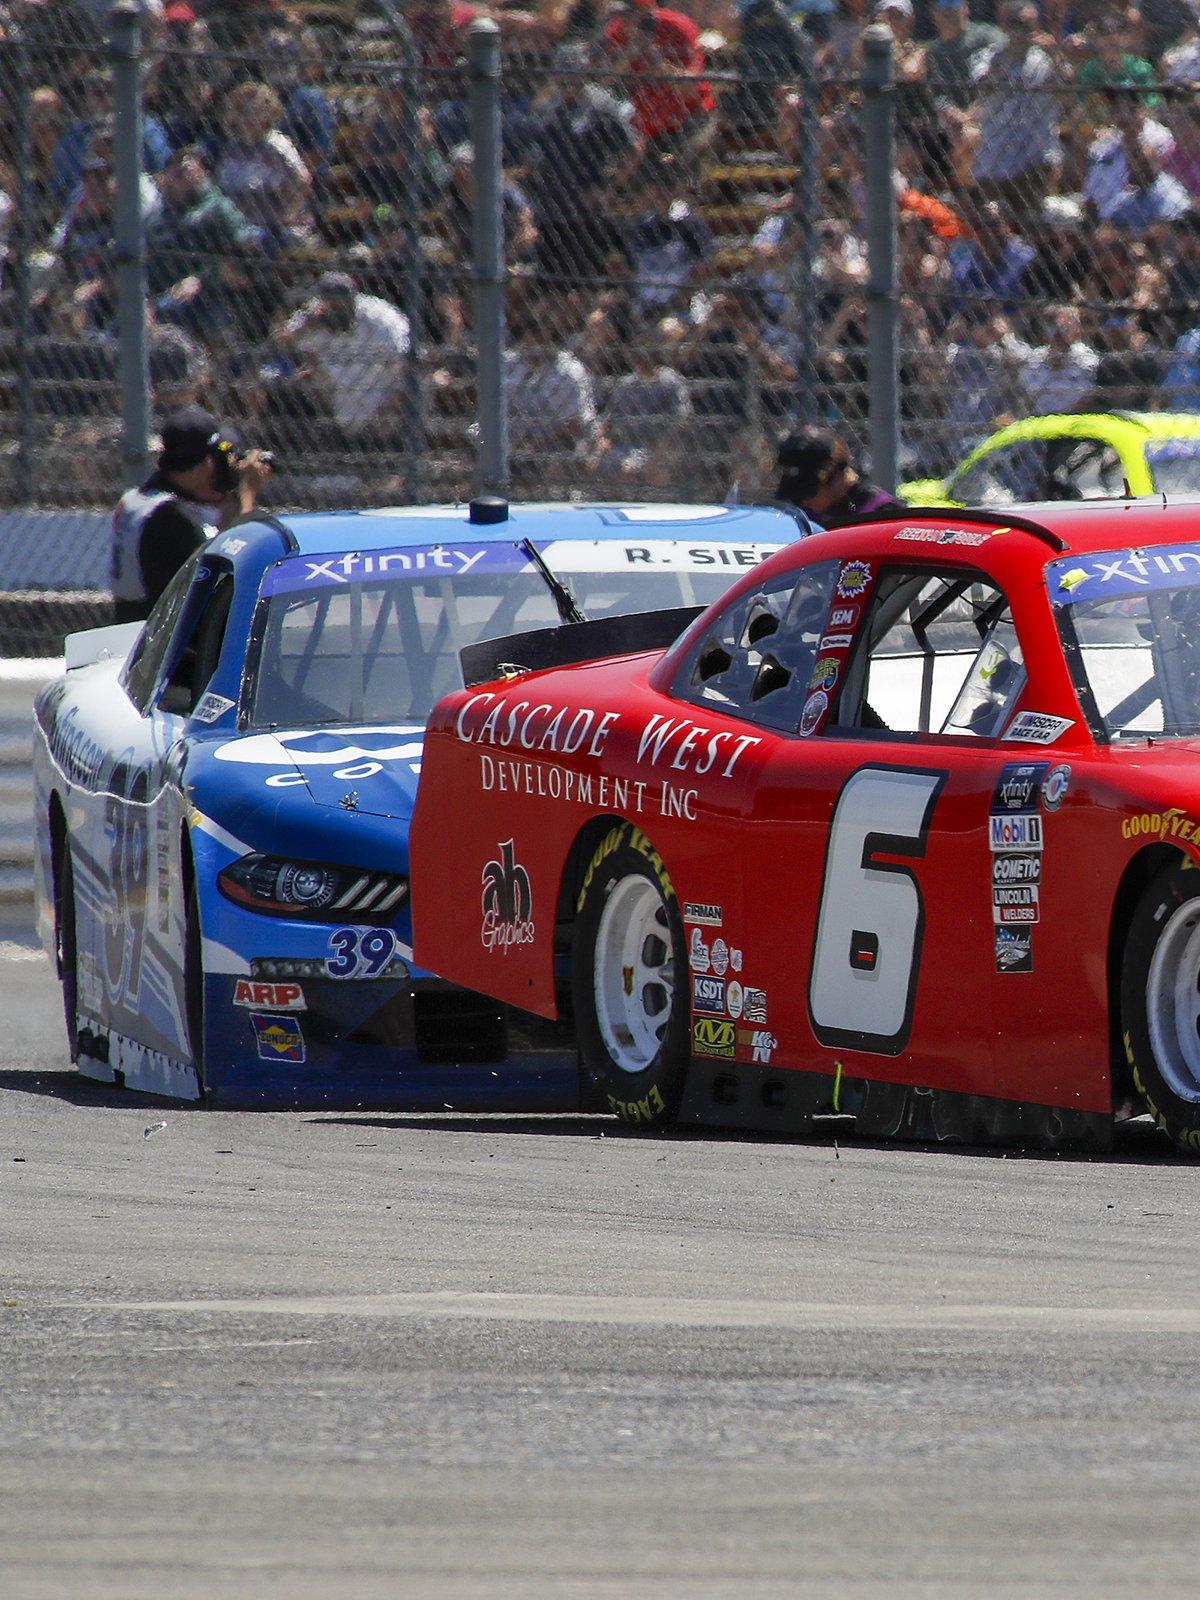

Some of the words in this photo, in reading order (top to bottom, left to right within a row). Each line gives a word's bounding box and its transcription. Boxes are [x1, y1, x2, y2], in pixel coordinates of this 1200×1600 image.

[305, 545, 486, 583] xfinity
[625, 548, 671, 564] R.
[830, 609, 854, 626] SEM
[1020, 713, 1062, 731] NASCAR
[455, 692, 620, 757] CASCADE
[636, 713, 763, 778] WEST
[1010, 727, 1032, 738] RACE
[1031, 730, 1051, 740] CAR
[480, 754, 647, 812] DEVELOPMENT
[659, 780, 700, 821] INC
[1000, 777, 1034, 804] xfinity
[992, 818, 1026, 843] Mobil
[993, 858, 1041, 879] COMETIC
[994, 888, 1031, 904] LINCOLN
[684, 903, 722, 920] FIRMAN
[808, 762, 951, 1057] 6
[1002, 907, 1036, 920] WELDERS
[324, 927, 398, 980] 39
[234, 981, 302, 1006] ARP
[694, 977, 724, 1001] KSDT
[258, 1032, 301, 1046] SUNOCO
